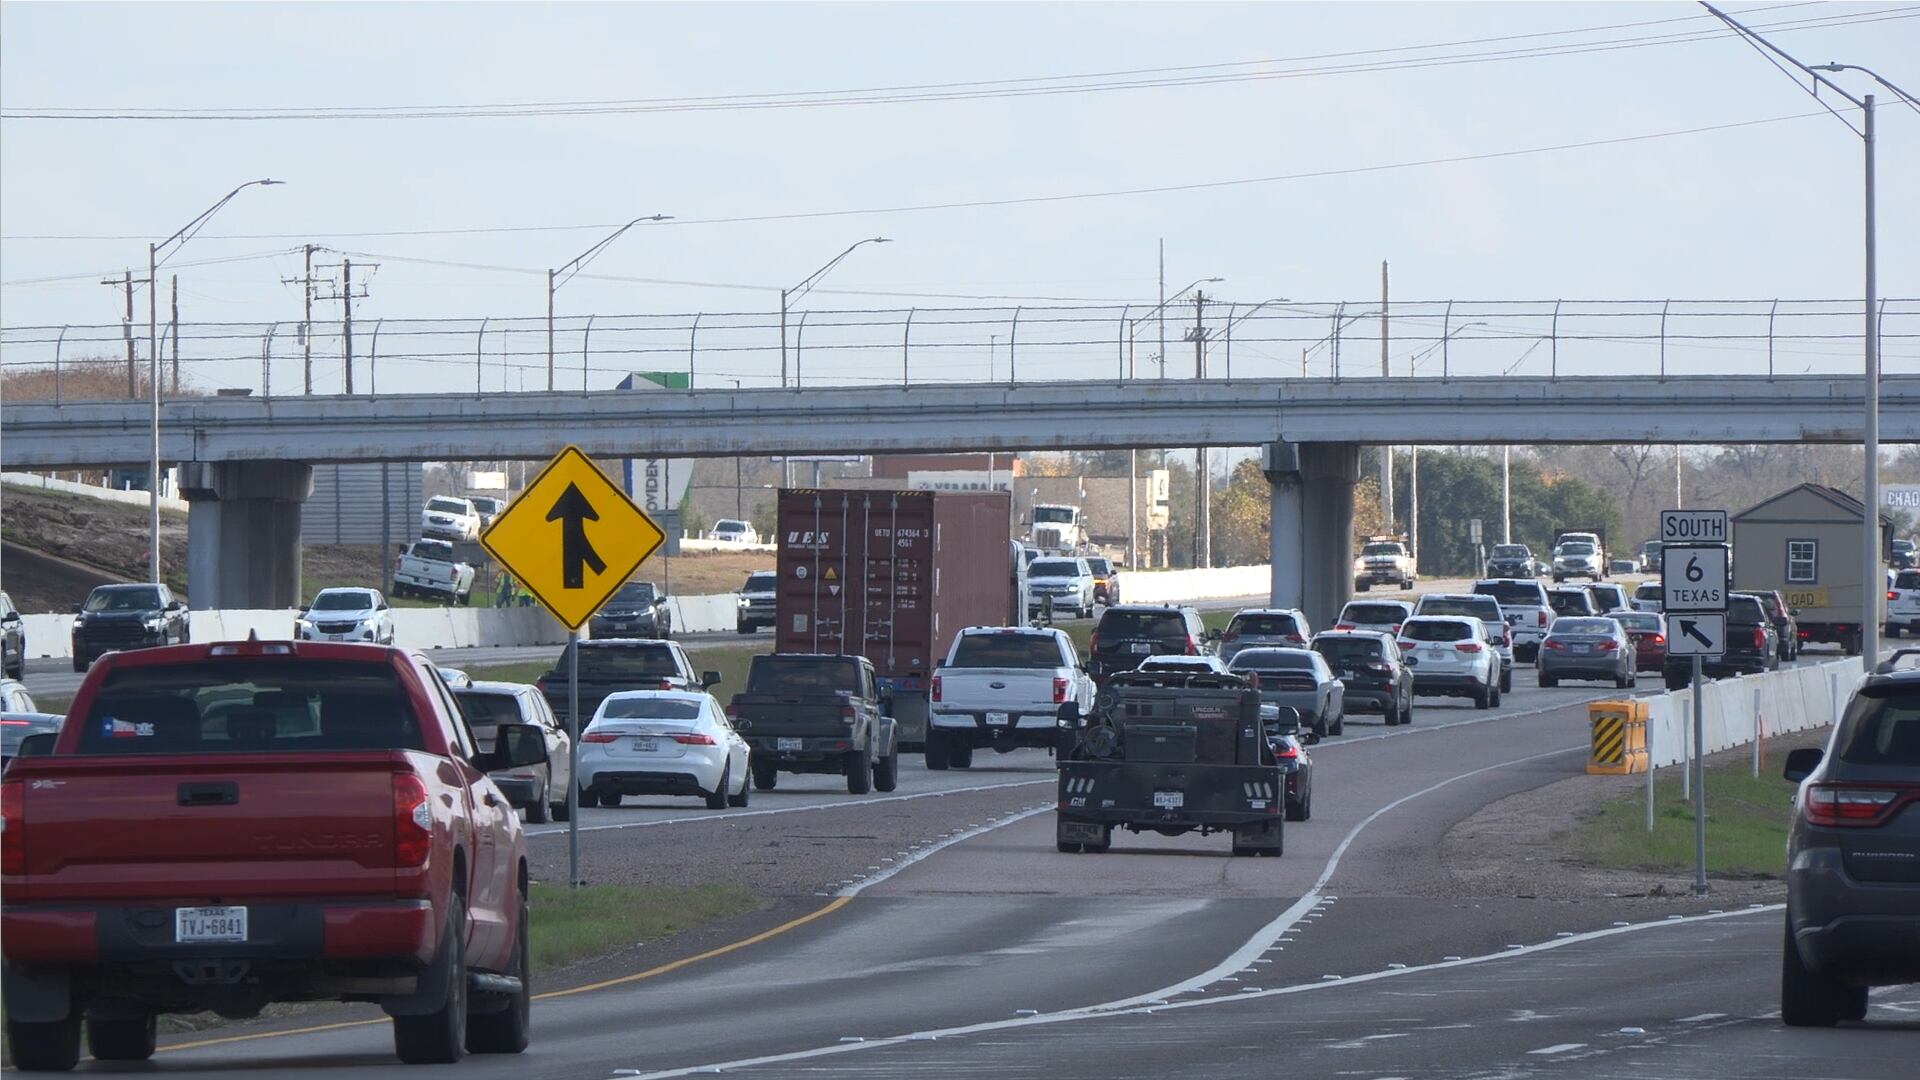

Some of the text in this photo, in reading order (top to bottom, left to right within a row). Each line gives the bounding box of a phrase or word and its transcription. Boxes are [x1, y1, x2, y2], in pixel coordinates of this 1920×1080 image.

[1665, 516, 1722, 537] SOUTH
[1686, 556, 1703, 582] 6
[1673, 589, 1720, 602] TEXAS
[199, 908, 225, 917] TEXAS
[181, 918, 242, 935] TVJ-6841
